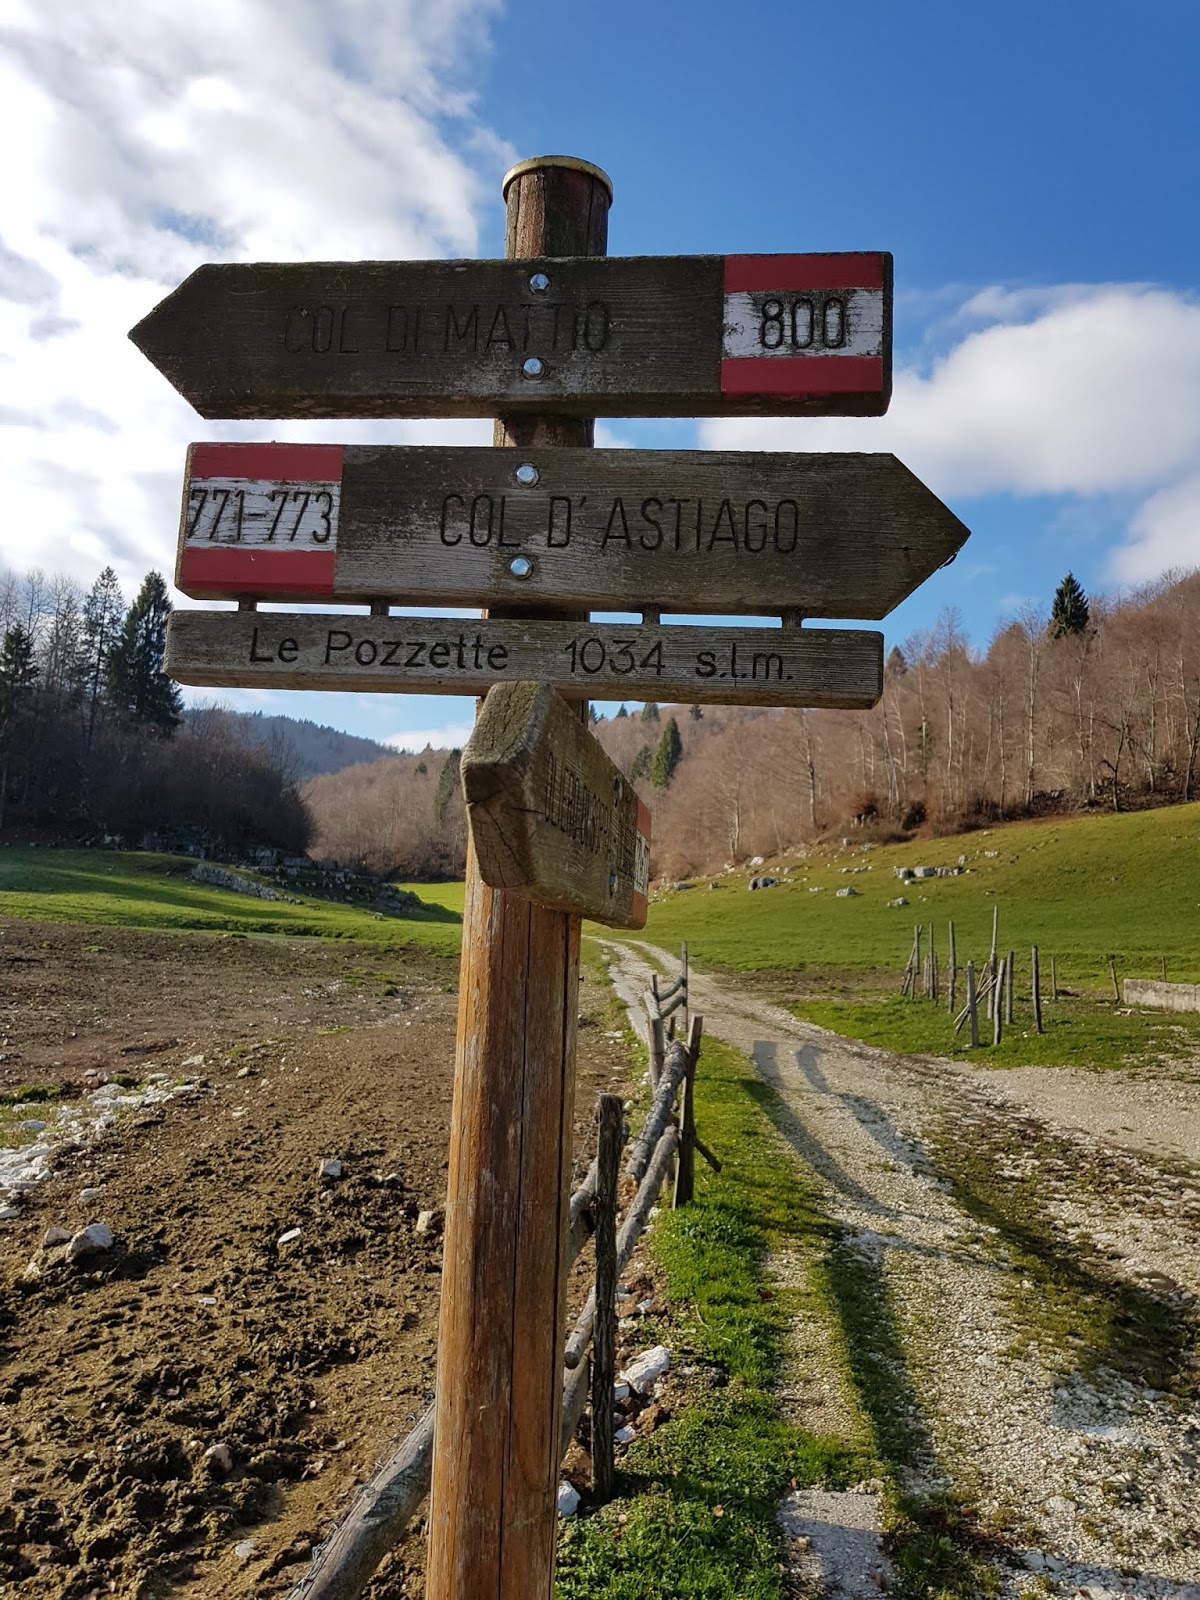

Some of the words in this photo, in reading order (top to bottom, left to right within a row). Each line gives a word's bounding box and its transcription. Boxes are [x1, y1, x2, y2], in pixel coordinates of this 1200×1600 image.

[284, 305, 359, 354] COL
[385, 305, 420, 353] DI
[444, 300, 612, 354] MATTIO
[761, 297, 845, 349] 800
[187, 488, 334, 543] 771-773
[440, 493, 521, 548] COL
[249, 627, 300, 664] Le
[325, 630, 509, 671] Pozzette
[564, 637, 667, 676] 1034
[695, 641, 795, 681] s.l.m.
